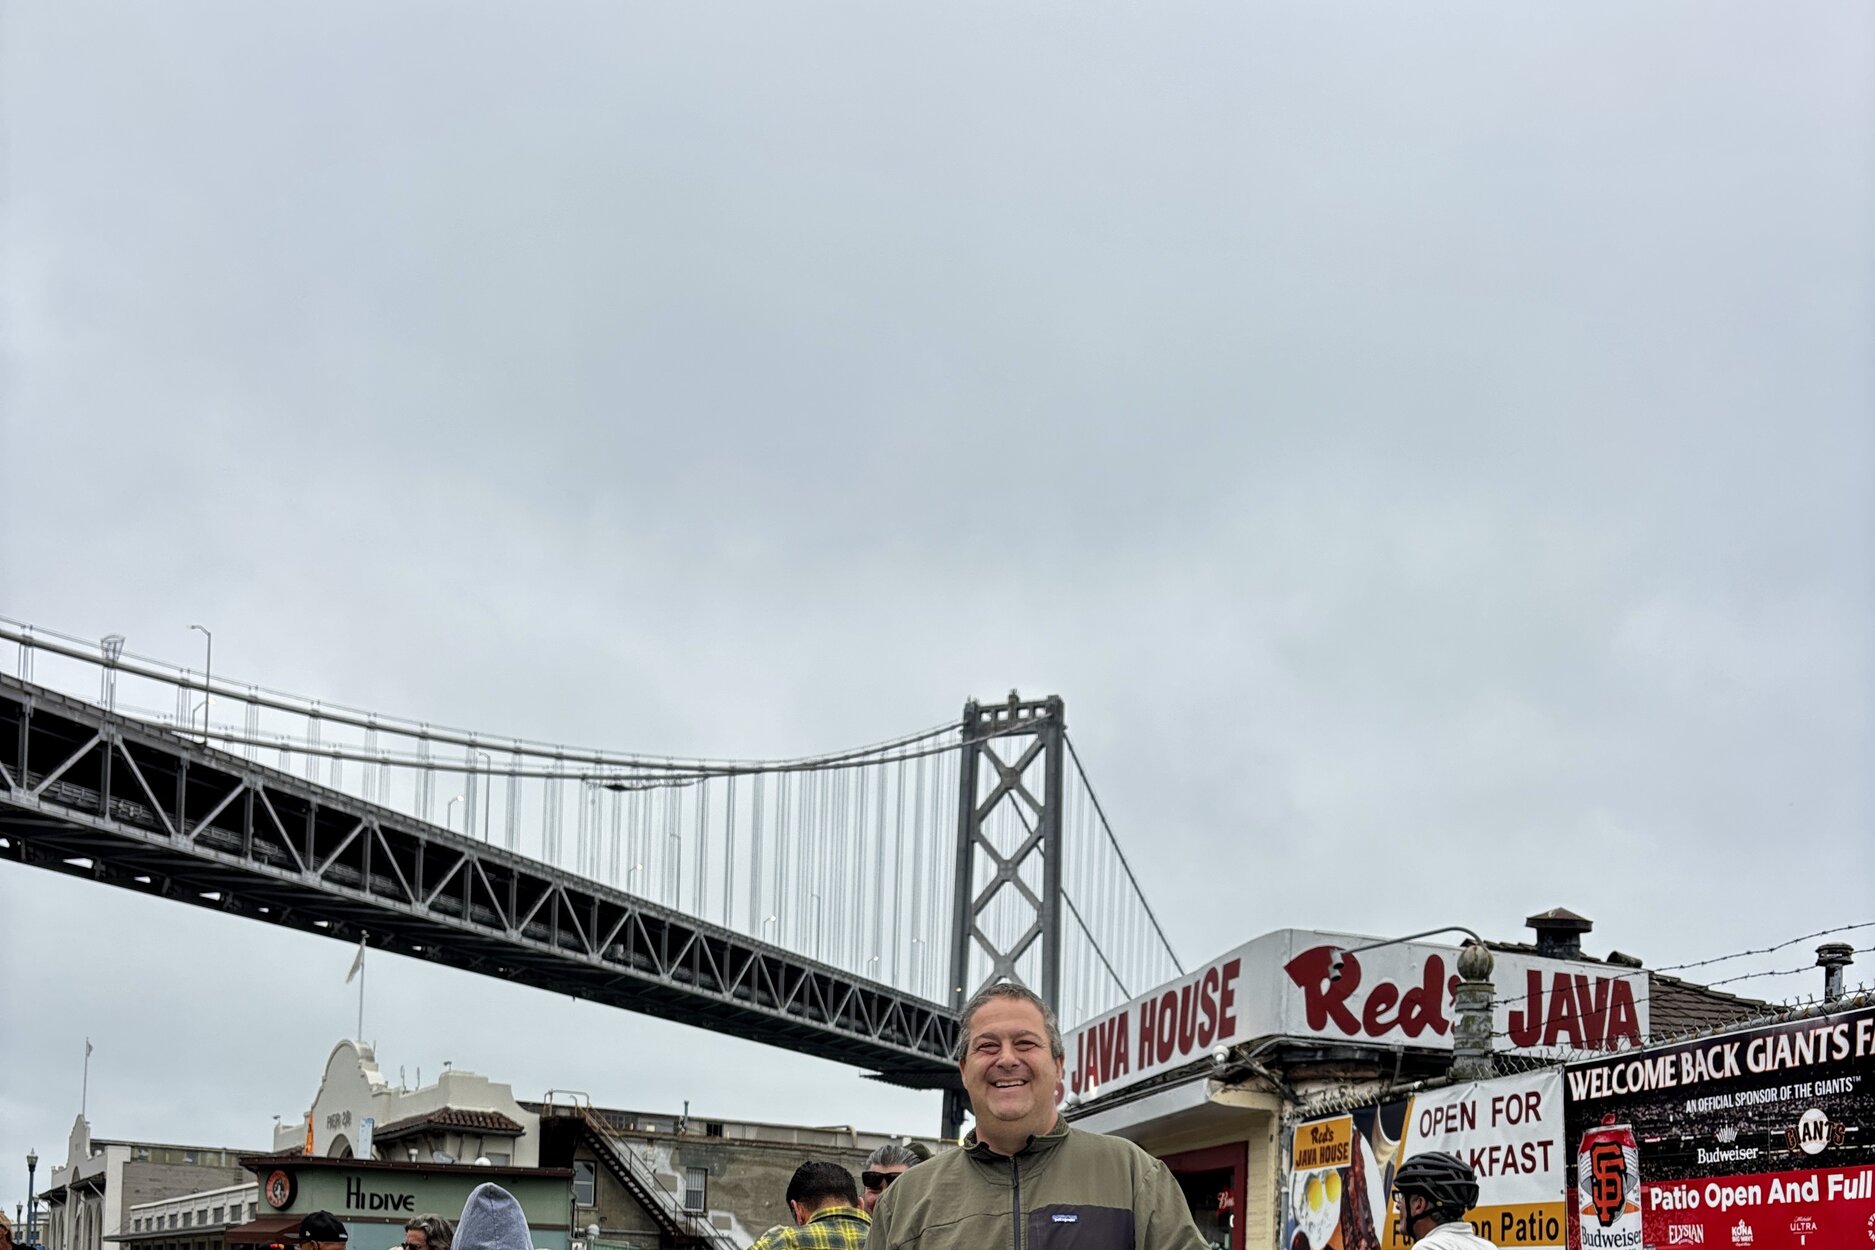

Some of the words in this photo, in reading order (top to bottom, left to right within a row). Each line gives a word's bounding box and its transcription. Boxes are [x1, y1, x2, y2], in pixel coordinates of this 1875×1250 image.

[1508, 969, 1643, 1050] JAVA
[1072, 1010, 1129, 1096] JAVA
[1138, 957, 1241, 1064] HOUSE
[1567, 1055, 1677, 1102] WELCOME
[1681, 1042, 1741, 1085] BACK
[1747, 1023, 1850, 1073] GIANTS
[1686, 1099, 1698, 1113] AN
[1698, 1096, 1734, 1112] OFFICIAL
[1735, 1090, 1778, 1107] SPONSOR
[1780, 1087, 1792, 1101] OF
[1794, 1083, 1813, 1099] THE
[1419, 1100, 1476, 1138] OPEN
[1491, 1091, 1542, 1127] FOR
[1310, 1126, 1335, 1145] Red's
[1784, 1120, 1846, 1150] GIANTS
[1295, 1149, 1317, 1168] JAVA
[1319, 1142, 1349, 1164] HOUSE
[1697, 1147, 1758, 1164] Budweiser
[369, 1192, 415, 1212] DIVE
[1651, 1184, 1700, 1211] Patio
[1704, 1182, 1762, 1212] Open
[1767, 1174, 1820, 1204] And
[1827, 1170, 1873, 1200] Full
[1501, 1210, 1560, 1242] Patio
[1582, 1227, 1642, 1248] Budweiser
[1668, 1223, 1705, 1245] ELYSIAN
[1790, 1222, 1818, 1231] ULTRA
